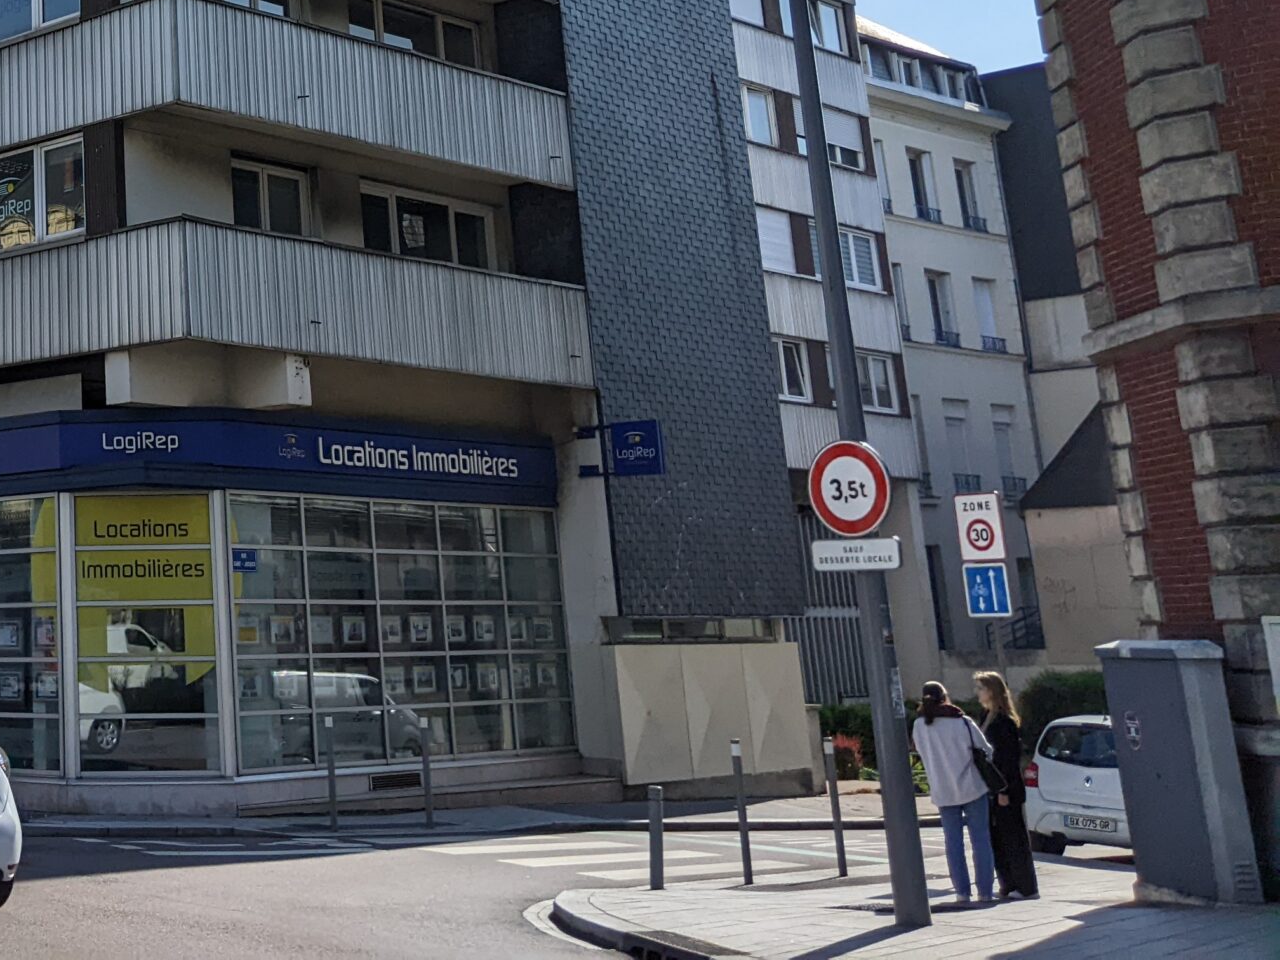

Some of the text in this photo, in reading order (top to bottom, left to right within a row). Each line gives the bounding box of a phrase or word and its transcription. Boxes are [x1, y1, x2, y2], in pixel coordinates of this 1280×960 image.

[102, 431, 179, 453] LogiRep
[318, 436, 519, 478] Locations Immobilières
[616, 446, 656, 460] LogiRep
[829, 478, 868, 504] 3,5t
[961, 500, 992, 512] ZONE
[93, 519, 189, 538] Locations
[971, 527, 989, 542] 30
[842, 545, 863, 553] SAUF
[818, 554, 893, 564] DESSERTE LOCALE
[82, 559, 205, 579] Immobilières
